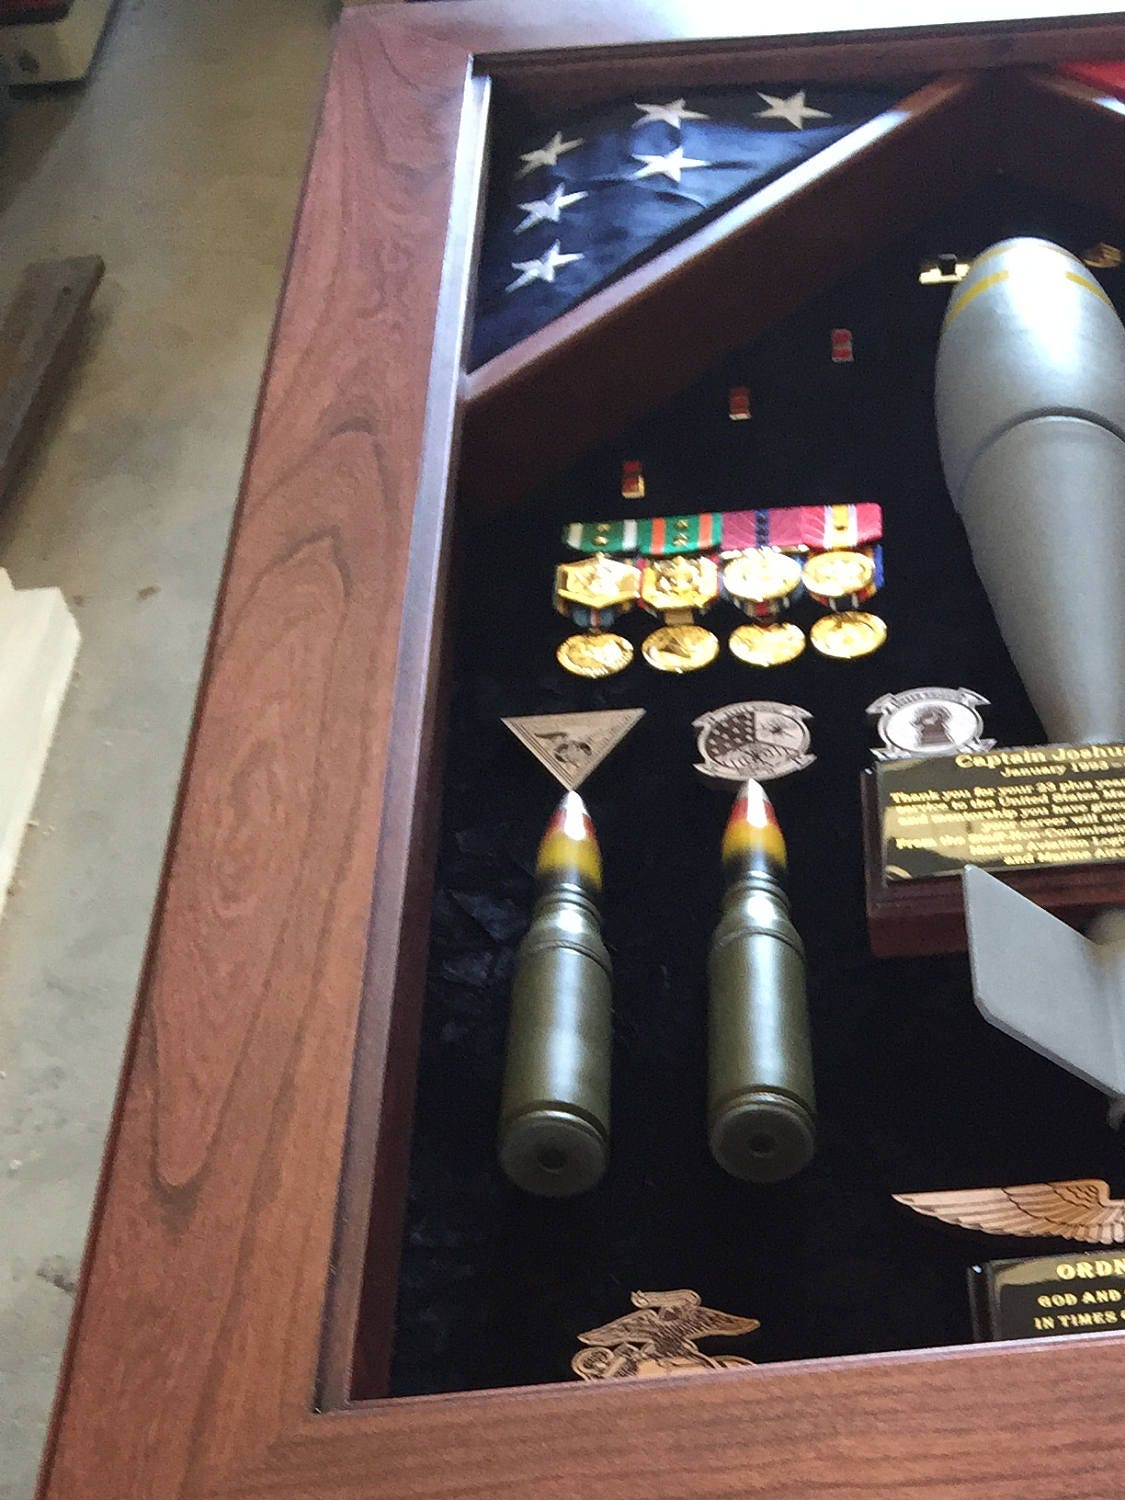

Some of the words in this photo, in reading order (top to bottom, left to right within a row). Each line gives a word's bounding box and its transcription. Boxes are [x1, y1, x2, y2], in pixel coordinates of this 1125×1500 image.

[955, 750, 1046, 769] Captain
[1000, 763, 1067, 778] January
[889, 789, 941, 804] Thank
[941, 788, 972, 802] you
[973, 785, 996, 798] for
[997, 784, 1034, 798] your
[1059, 779, 1094, 794] plus
[950, 799, 968, 811] to
[970, 798, 996, 810] the
[998, 793, 1050, 808] United
[1051, 791, 1100, 804] States
[896, 815, 929, 827] and
[1019, 806, 1050, 818] you
[1051, 802, 1089, 815] have
[980, 820, 1018, 834] your
[1019, 816, 1068, 829] career
[1070, 812, 1100, 825] will
[895, 837, 938, 850] From
[938, 834, 966, 846] the
[968, 842, 1024, 856] Marine
[1025, 837, 1090, 852] Aviation
[1003, 853, 1036, 866] and
[1036, 850, 1092, 864] Marine
[1037, 1293, 1078, 1309] GOD
[1080, 1289, 1122, 1305] AND
[1033, 1316, 1056, 1331] IN
[1057, 1310, 1118, 1328] TIMES
